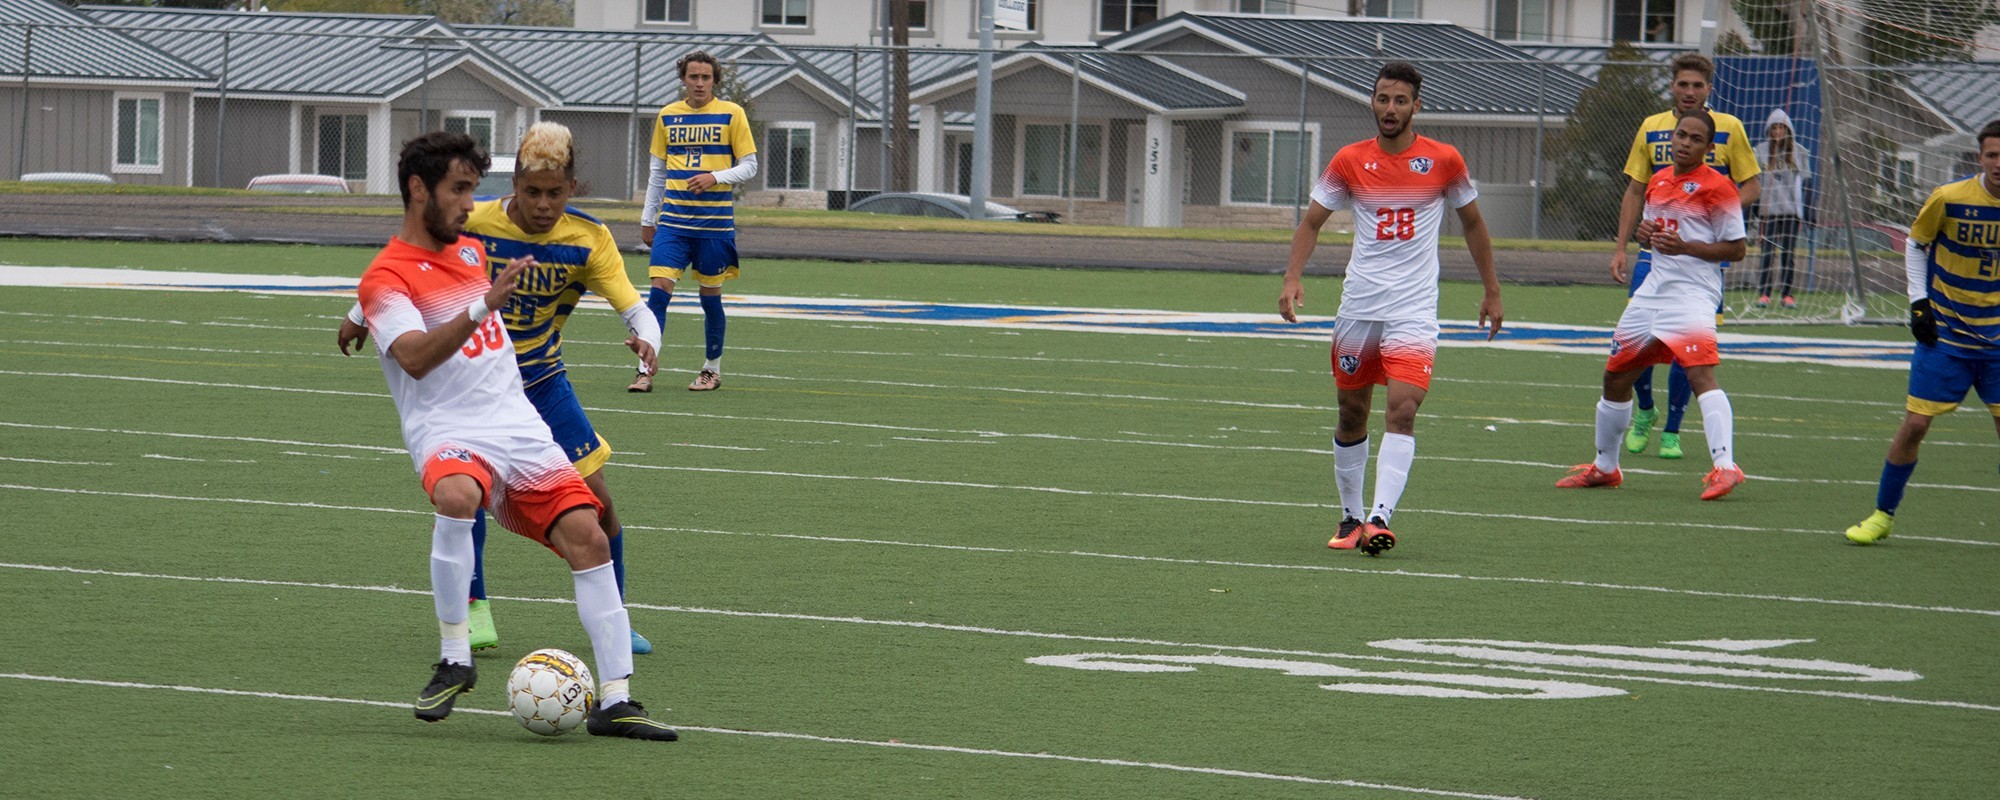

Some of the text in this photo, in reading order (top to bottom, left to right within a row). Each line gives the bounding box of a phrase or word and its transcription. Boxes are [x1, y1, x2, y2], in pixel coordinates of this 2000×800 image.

[669, 127, 722, 143] BRUINS
[685, 146, 703, 168] 13
[1149, 137, 1159, 175] 355
[1655, 144, 1715, 163] BRS
[1376, 207, 1416, 241] 28
